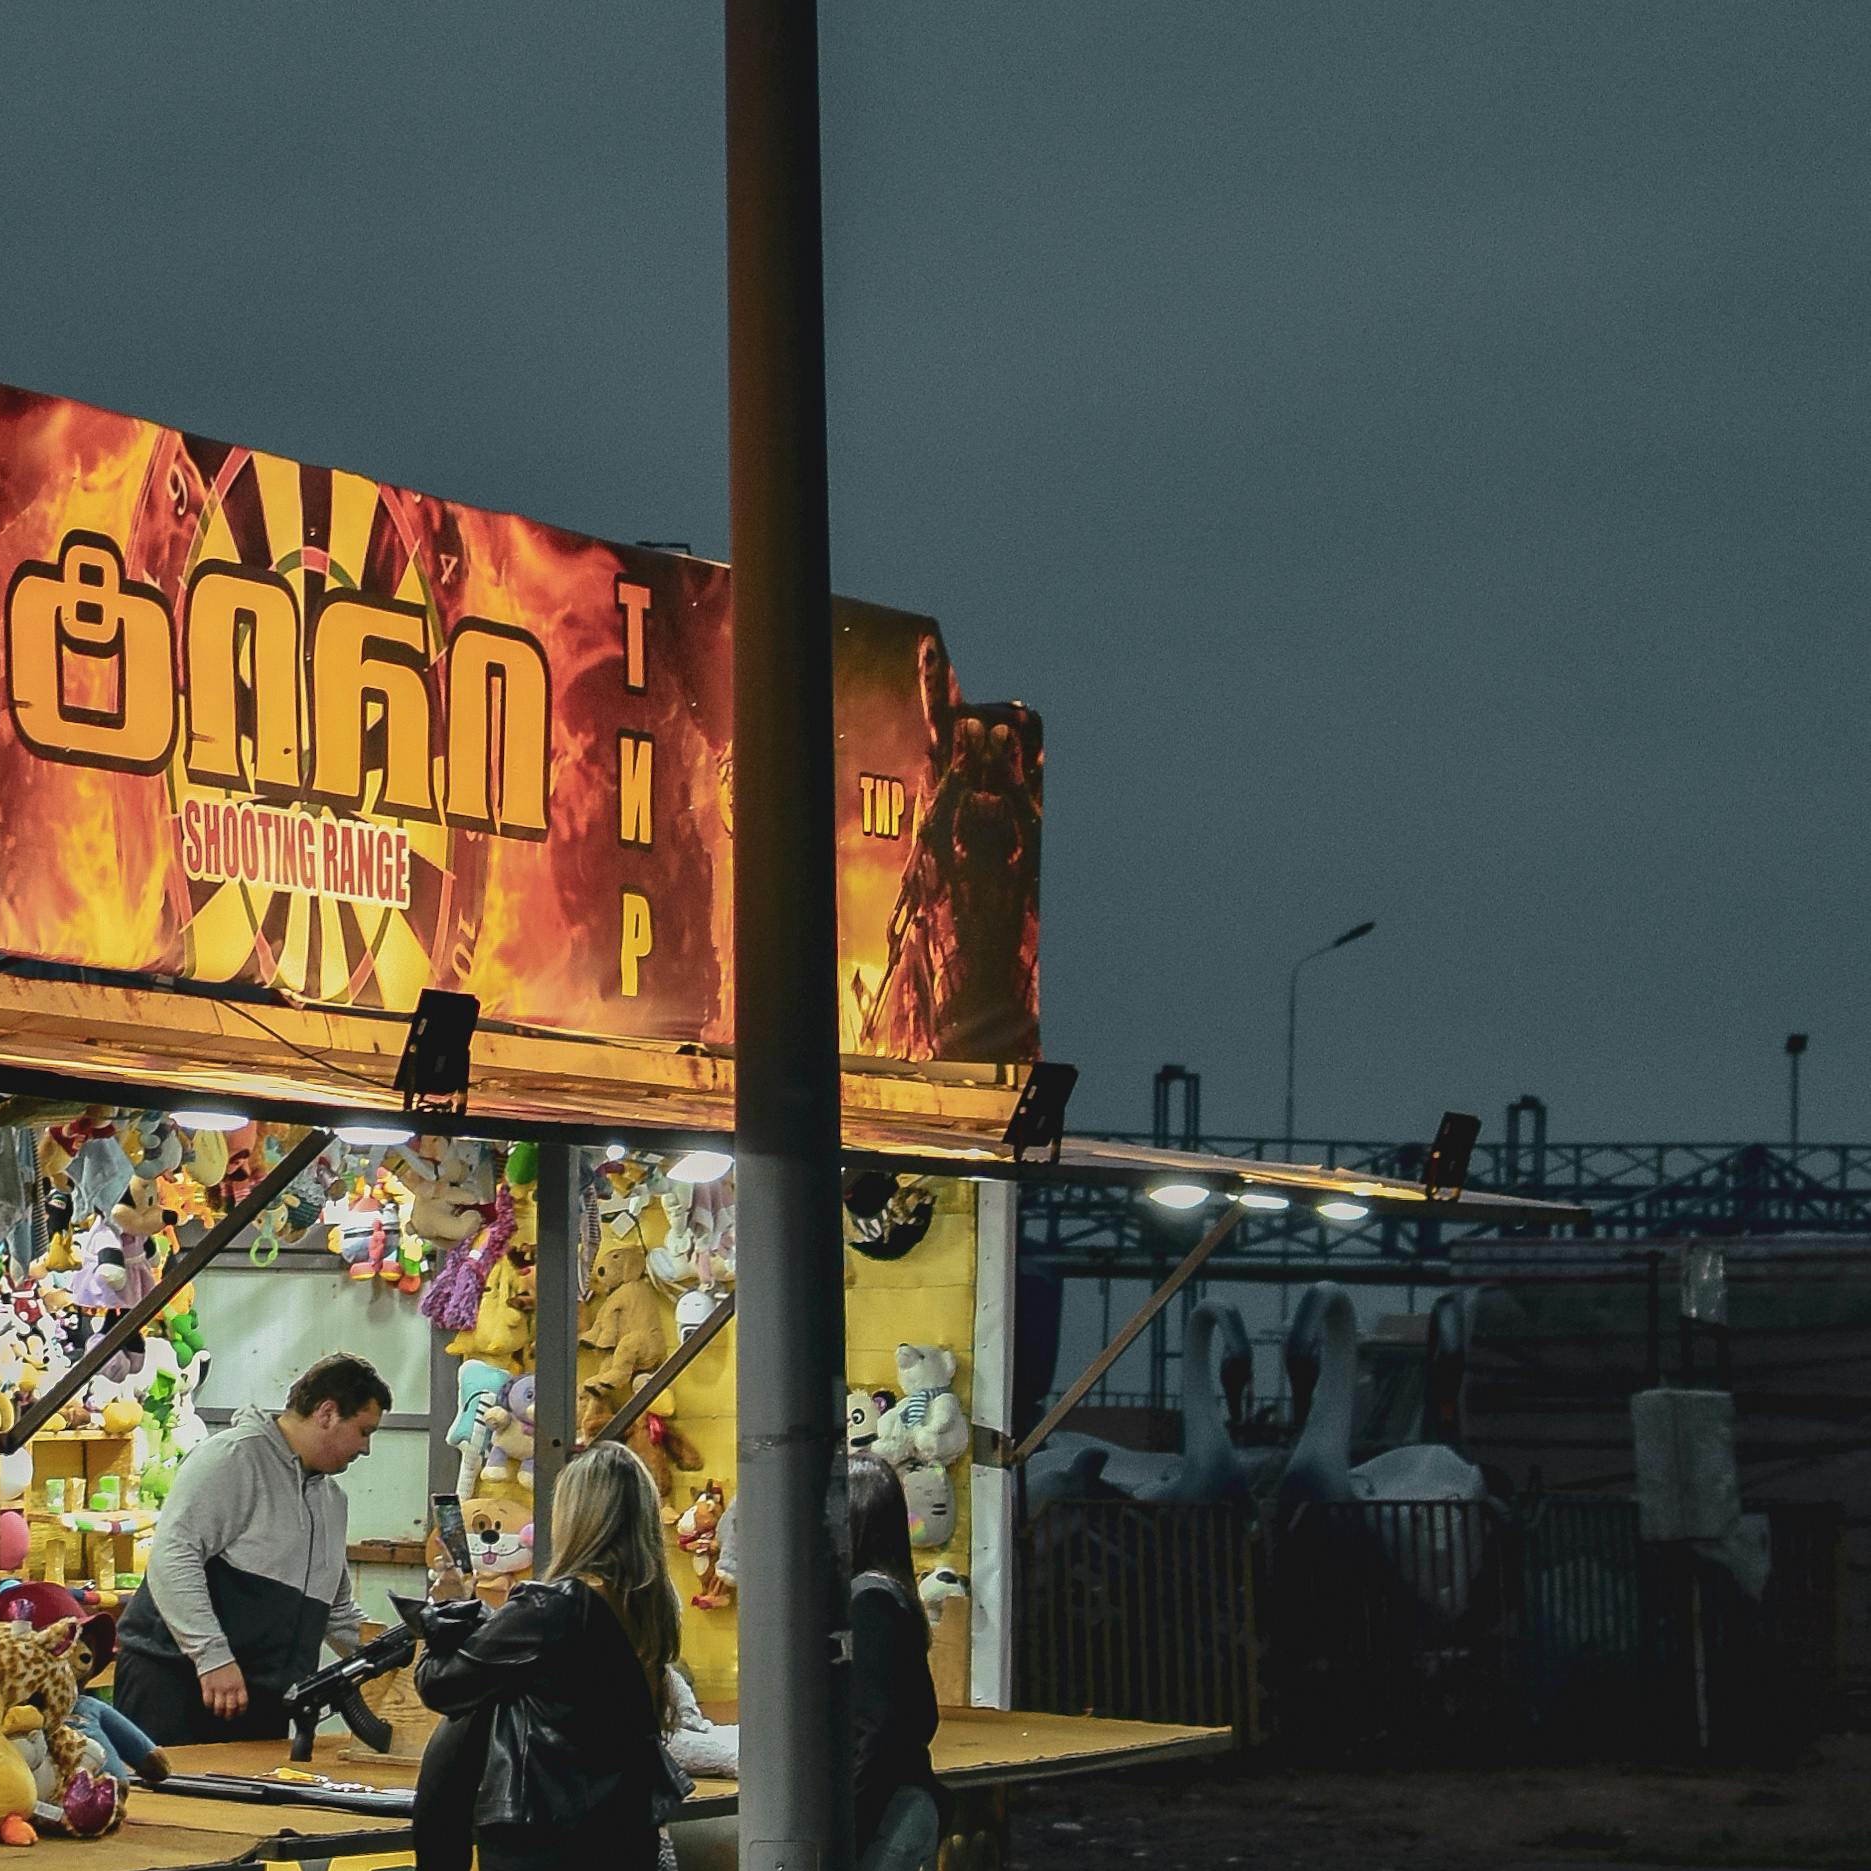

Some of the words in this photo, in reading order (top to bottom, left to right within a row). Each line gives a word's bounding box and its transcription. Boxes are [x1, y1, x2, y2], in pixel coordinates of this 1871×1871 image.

[618, 581, 653, 997] ТИР
[859, 775, 906, 838] ТИР
[184, 799, 317, 890] SHOOTING
[323, 820, 409, 904] RANGE
